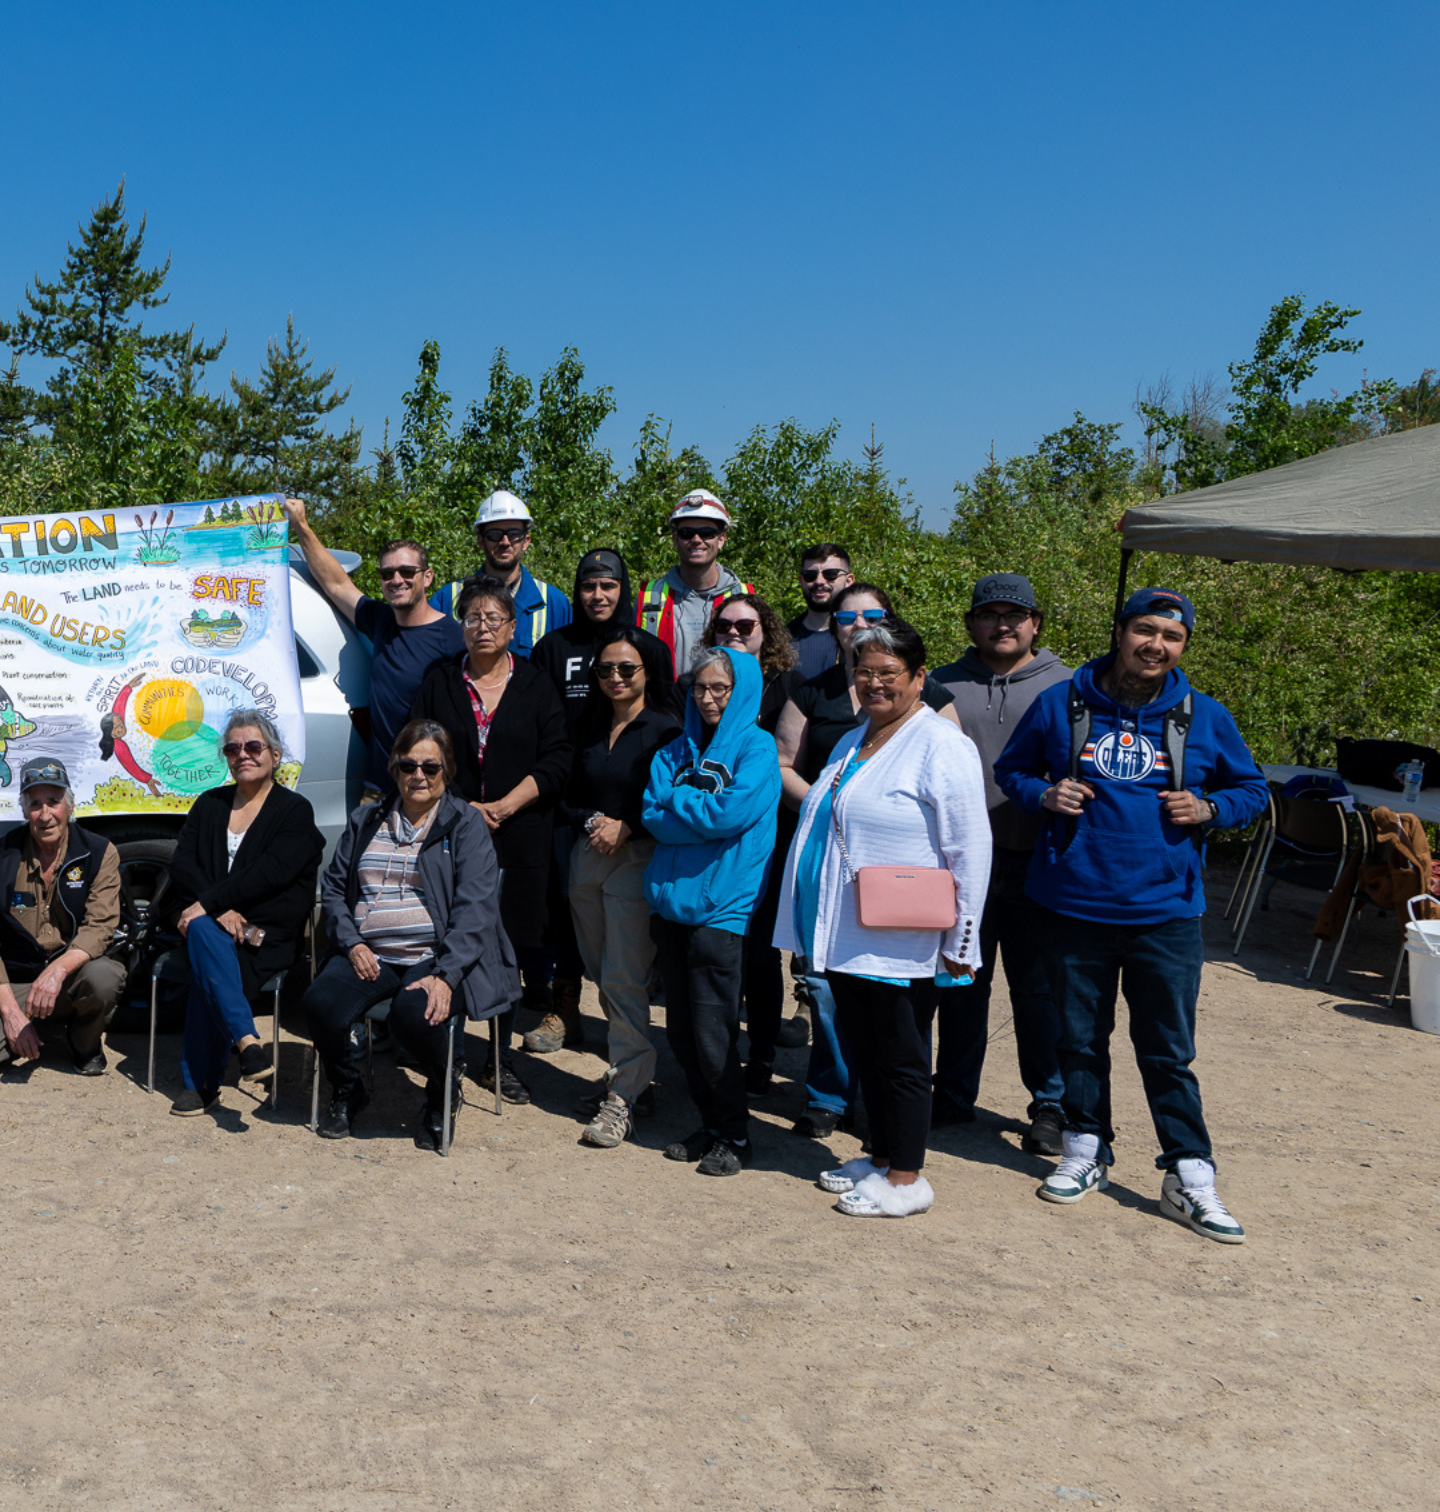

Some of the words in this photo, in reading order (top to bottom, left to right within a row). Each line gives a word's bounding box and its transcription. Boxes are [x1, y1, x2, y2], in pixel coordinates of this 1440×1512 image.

[19, 556, 117, 575] TOMORROW
[60, 590, 80, 604] The
[81, 582, 122, 602] LAND
[124, 583, 150, 593] needs
[155, 581, 165, 590] to
[169, 580, 183, 590] be
[193, 575, 266, 605] SAFE
[983, 580, 1019, 594] Good
[11, 618, 41, 640] concerns
[43, 639, 66, 652] about
[97, 650, 125, 662] quality
[50, 613, 126, 651] USERS
[96, 676, 121, 713] SPIRIT
[139, 659, 159, 670] LAND
[138, 686, 185, 726] COMMUNITIES
[158, 753, 221, 783] TOGETHER
[1103, 747, 1148, 764] OLERS
